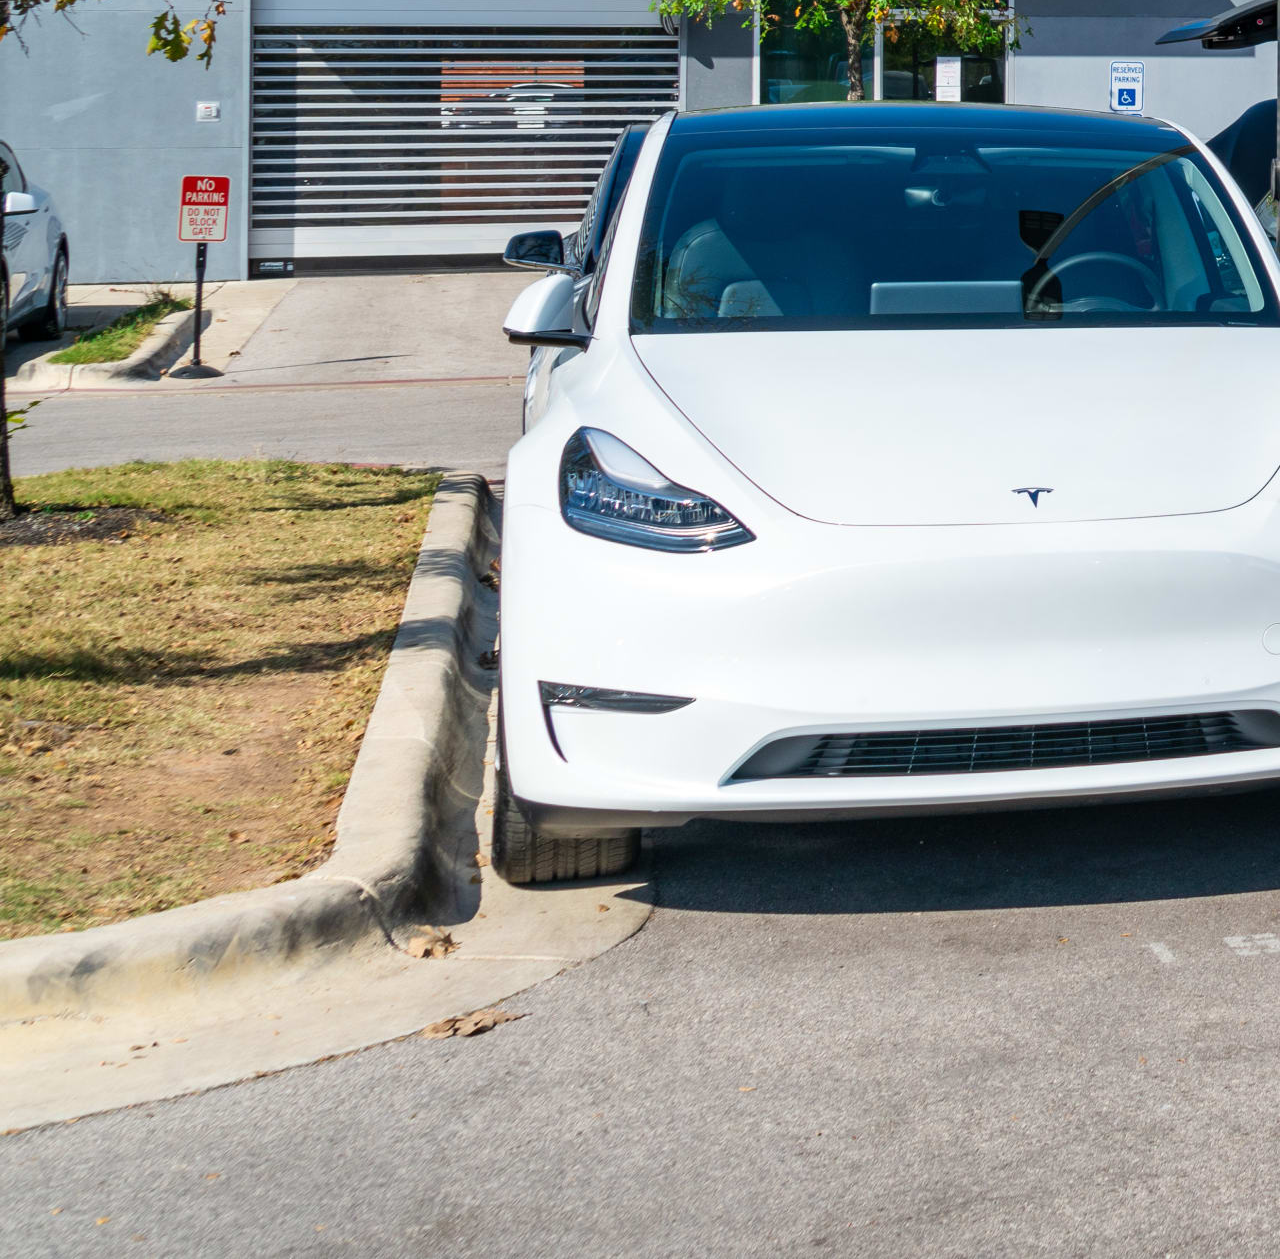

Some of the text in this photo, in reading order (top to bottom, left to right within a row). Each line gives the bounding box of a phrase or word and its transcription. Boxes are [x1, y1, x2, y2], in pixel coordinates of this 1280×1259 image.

[1112, 66, 1143, 74] RESERVED
[197, 179, 216, 191] NO
[185, 192, 225, 203] PARKING
[187, 208, 220, 217] DO NOT
[189, 218, 218, 226] BLOCK
[192, 227, 214, 236] GATE
